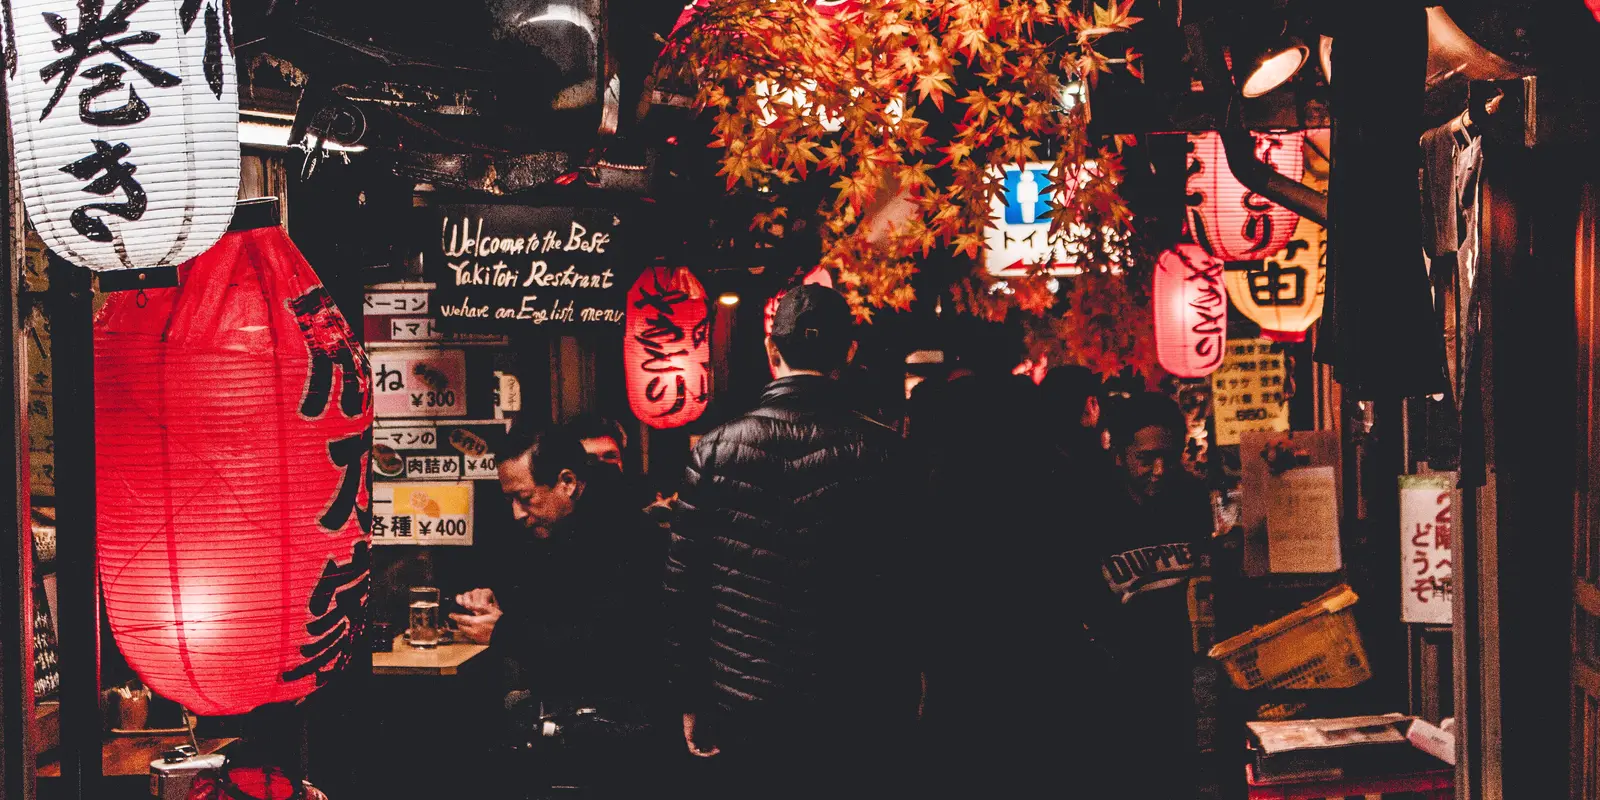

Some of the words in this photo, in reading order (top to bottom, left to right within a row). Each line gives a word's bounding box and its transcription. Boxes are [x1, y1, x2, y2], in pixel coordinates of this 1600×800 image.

[38, 0, 183, 242] 巻き
[442, 216, 525, 258] Welcome
[525, 233, 540, 255] to
[541, 231, 562, 254] the
[522, 260, 615, 289] Restrant
[580, 304, 625, 326] menu
[393, 319, 437, 337] トマト
[376, 363, 405, 392] ね
[411, 391, 455, 408] ¥300
[408, 458, 458, 474] 肉詰め
[372, 515, 412, 537] 各種
[418, 519, 467, 536] ¥400
[1411, 523, 1435, 603] どうぞ
